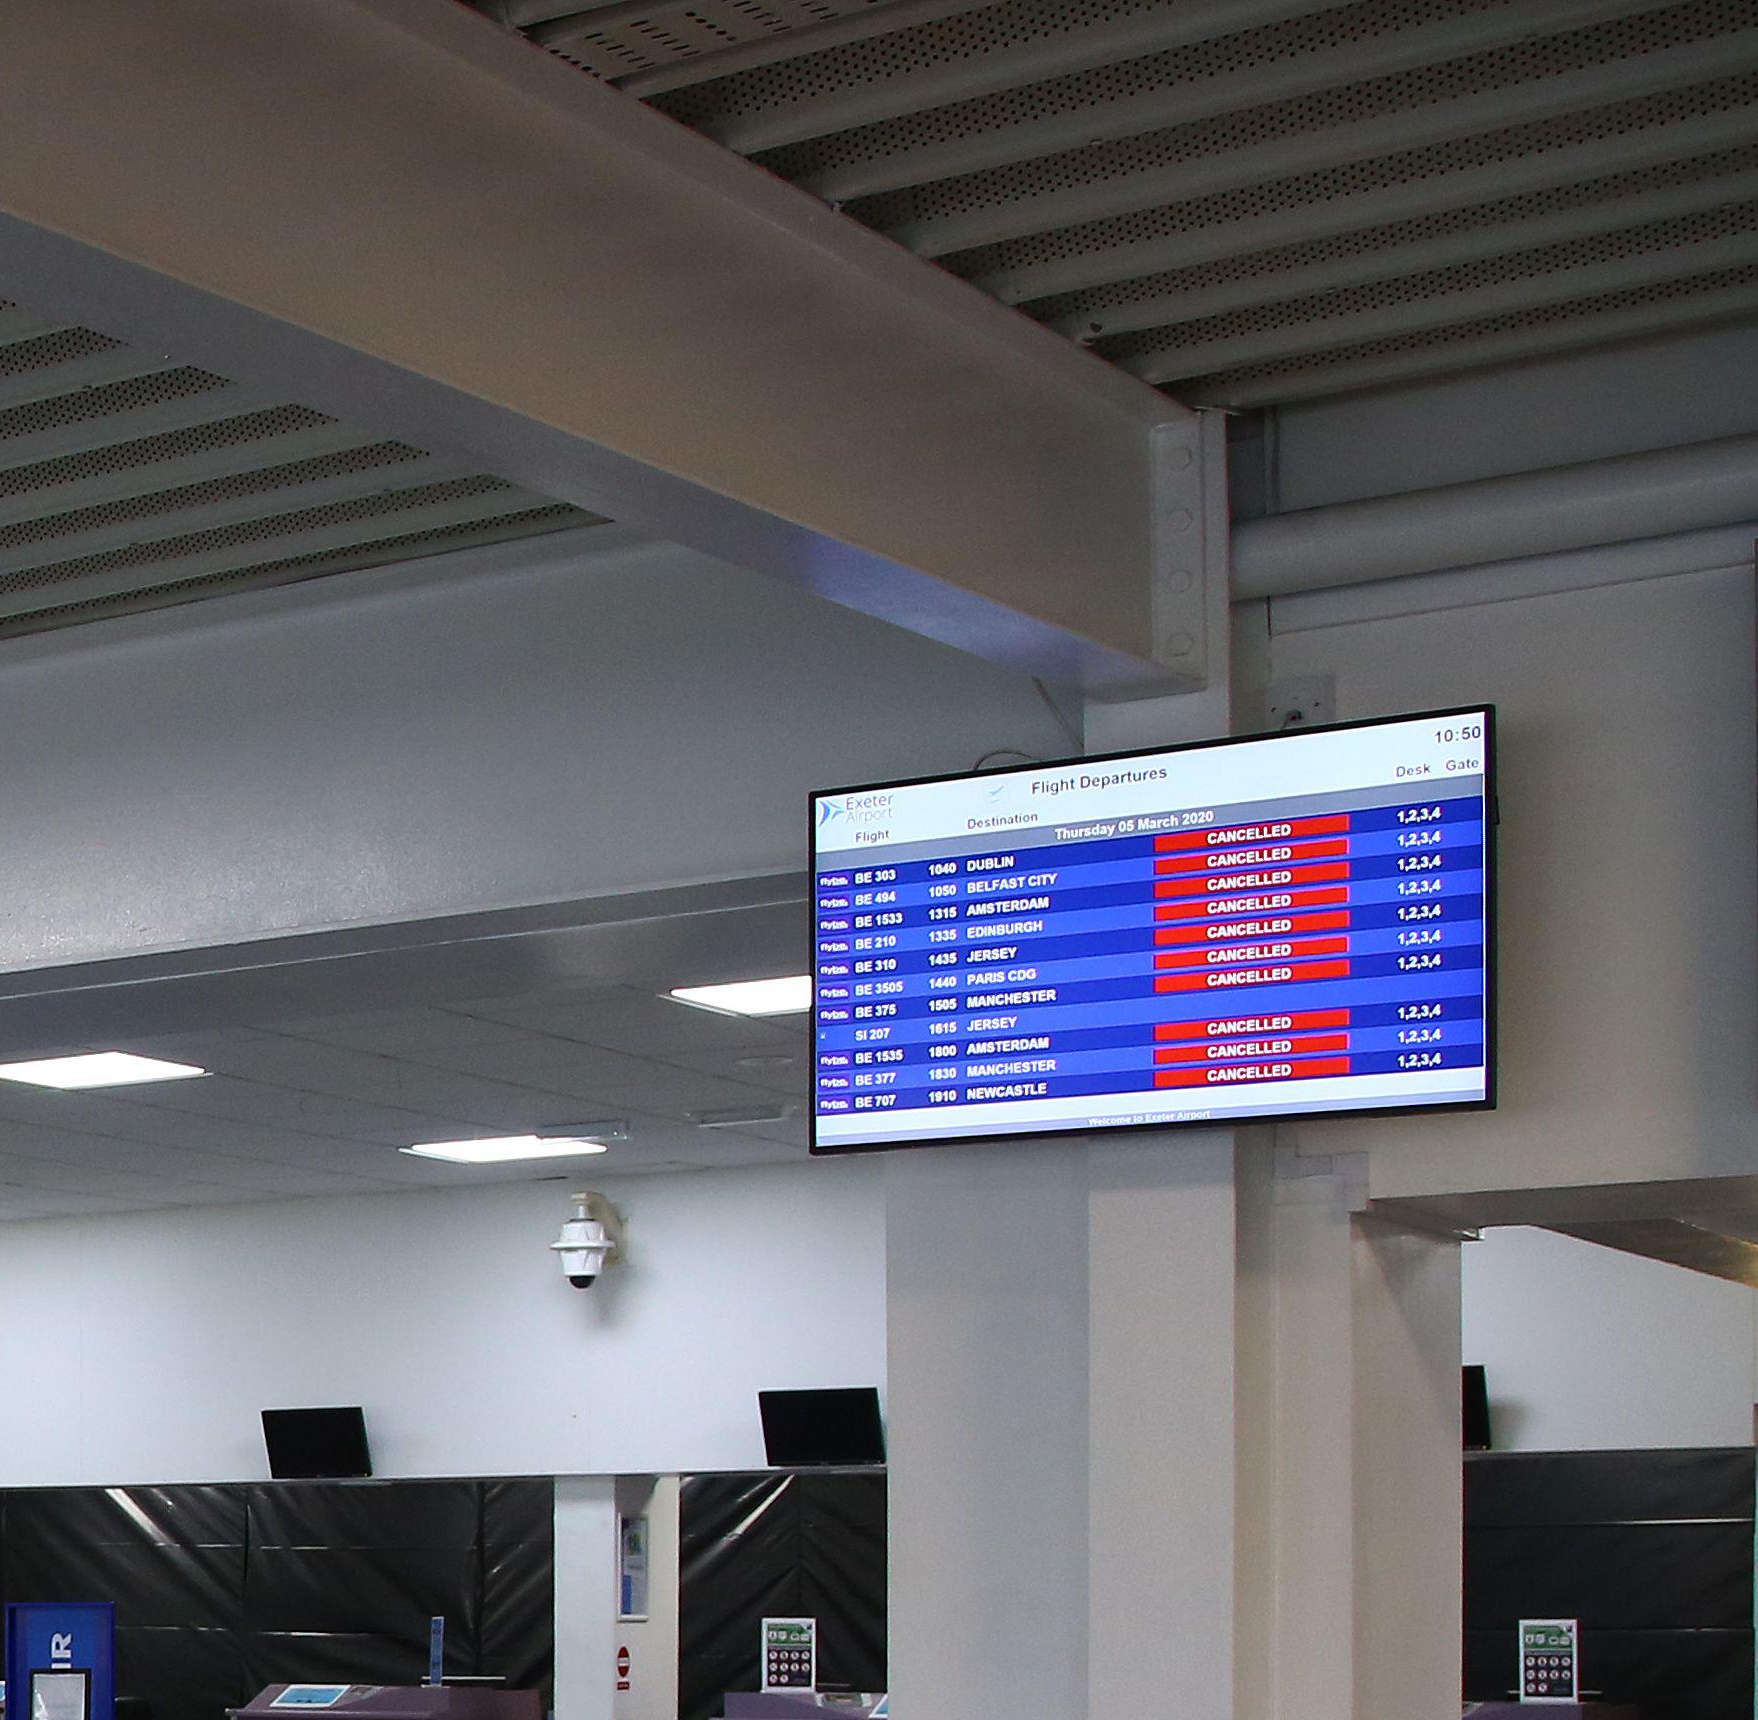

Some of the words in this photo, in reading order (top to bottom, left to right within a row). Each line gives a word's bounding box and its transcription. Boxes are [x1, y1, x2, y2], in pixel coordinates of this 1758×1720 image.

[1435, 725, 1482, 744] 10:50
[1031, 776, 1075, 796] Flight
[1080, 766, 1168, 791] Departures
[1396, 763, 1431, 778] Desk
[1445, 757, 1480, 772] Gate
[845, 793, 894, 811] Exeter
[845, 808, 894, 825] Airport
[855, 830, 890, 844] Flight
[967, 813, 1039, 830] Destination
[1055, 821, 1116, 843] Thursday
[1118, 820, 1136, 833] 05
[1138, 814, 1179, 831] March
[1182, 810, 1215, 825] 2020
[855, 872, 872, 884] BE
[875, 869, 896, 882] 303
[967, 855, 1015, 872] DUBLIN
[1206, 824, 1292, 846] CANCELLED
[1397, 806, 1442, 824] 1,2,3,4
[855, 894, 872, 906] BE
[875, 891, 896, 904] 494
[929, 885, 957, 898] 1050
[967, 877, 1026, 894] BELFAST
[1028, 873, 1058, 888] CITY
[1206, 847, 1292, 868] CANCELLED
[1397, 831, 1442, 848] 1,2,3,4
[855, 916, 872, 928] BE
[875, 912, 903, 926] 1533
[929, 907, 957, 921] 1315
[967, 897, 1050, 917] AMSTERDAM
[1206, 870, 1292, 892] CANCELLED
[1397, 855, 1442, 872] 1,2,3,4
[855, 938, 872, 950] BE
[875, 935, 896, 948] 210
[929, 929, 957, 943] 1335
[967, 920, 1043, 939] EDINBURGH
[1206, 894, 1292, 915] CANCELLED
[1397, 878, 1442, 896] 1,2,3,4
[855, 961, 872, 974] BE
[875, 958, 896, 971] 310
[929, 952, 957, 966] 1435
[967, 947, 1017, 963] JERSEY
[1206, 919, 1292, 940] CANCELLED
[1397, 904, 1442, 921] 1,2,3,4
[855, 984, 872, 996] BE
[875, 981, 903, 994] 3505
[929, 976, 957, 989] 1440
[967, 971, 1004, 986] PARIS
[1007, 969, 1037, 982] CDG
[1206, 943, 1292, 963] CANCELLED
[1397, 929, 1442, 946] 1,2,3,4
[855, 1006, 872, 1018] BE
[875, 1003, 897, 1016] 375
[929, 998, 957, 1011] 1505
[967, 989, 1057, 1009] MANCHESTER
[1206, 967, 1292, 987] CANCELLED
[1397, 953, 1442, 971] 1,2,3,4
[855, 1030, 867, 1041] SI
[869, 1028, 890, 1040] 207
[967, 1016, 1017, 1032] JERSEY
[855, 1052, 872, 1065] BE
[875, 1049, 903, 1062] 1535
[929, 1045, 957, 1058] 1800
[967, 1037, 1050, 1056] AMSTERDAM
[1206, 1016, 1292, 1036] CANCELLED
[1397, 1003, 1442, 1021] 1,2,3,4
[855, 1074, 872, 1087] BE
[875, 1072, 896, 1085] 377
[929, 1067, 957, 1081] 1830
[967, 1059, 1057, 1078] MANCHESTER
[1206, 1040, 1292, 1060] CANCELLED
[1397, 1028, 1442, 1045] 1,2,3,4
[855, 1096, 872, 1109] BE
[875, 1094, 896, 1107] 707
[929, 1090, 957, 1103] 1910
[967, 1083, 1047, 1101] NEWCASTLE
[1206, 1063, 1292, 1083] CANCELLED
[1397, 1052, 1442, 1069] 1,2,3,4
[1088, 1115, 1132, 1126] Welcome
[1145, 1111, 1175, 1123] Exeter
[1177, 1109, 1212, 1122] Airport
